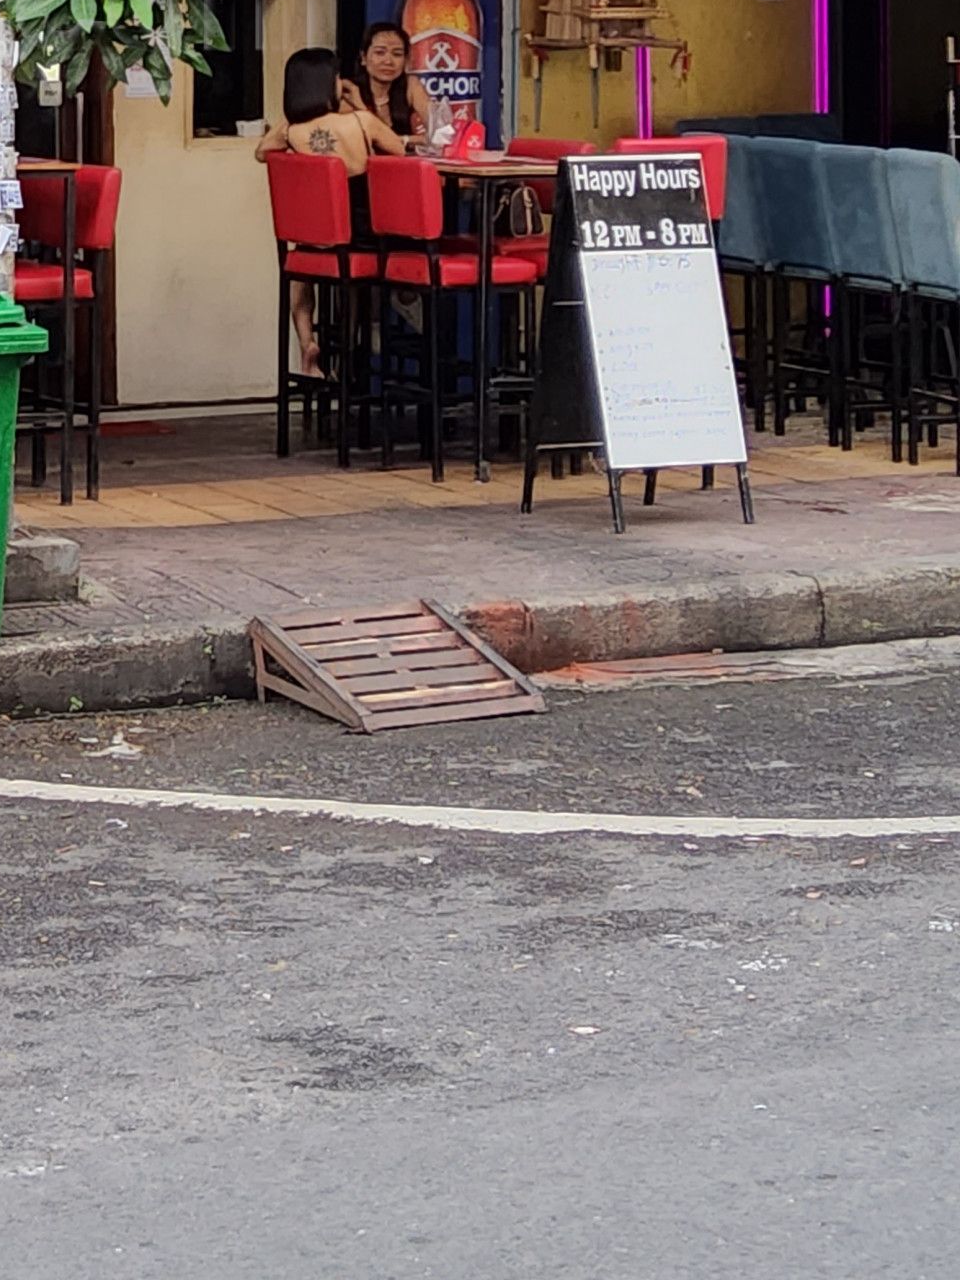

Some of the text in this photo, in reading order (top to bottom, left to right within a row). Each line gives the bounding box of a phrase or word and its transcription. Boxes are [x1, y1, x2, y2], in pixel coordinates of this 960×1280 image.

[421, 76, 480, 96] CHOR
[572, 163, 701, 198] Happy Hours
[580, 220, 610, 248] 12
[612, 225, 643, 247] PM
[659, 218, 677, 246] 8
[679, 223, 708, 246] PM
